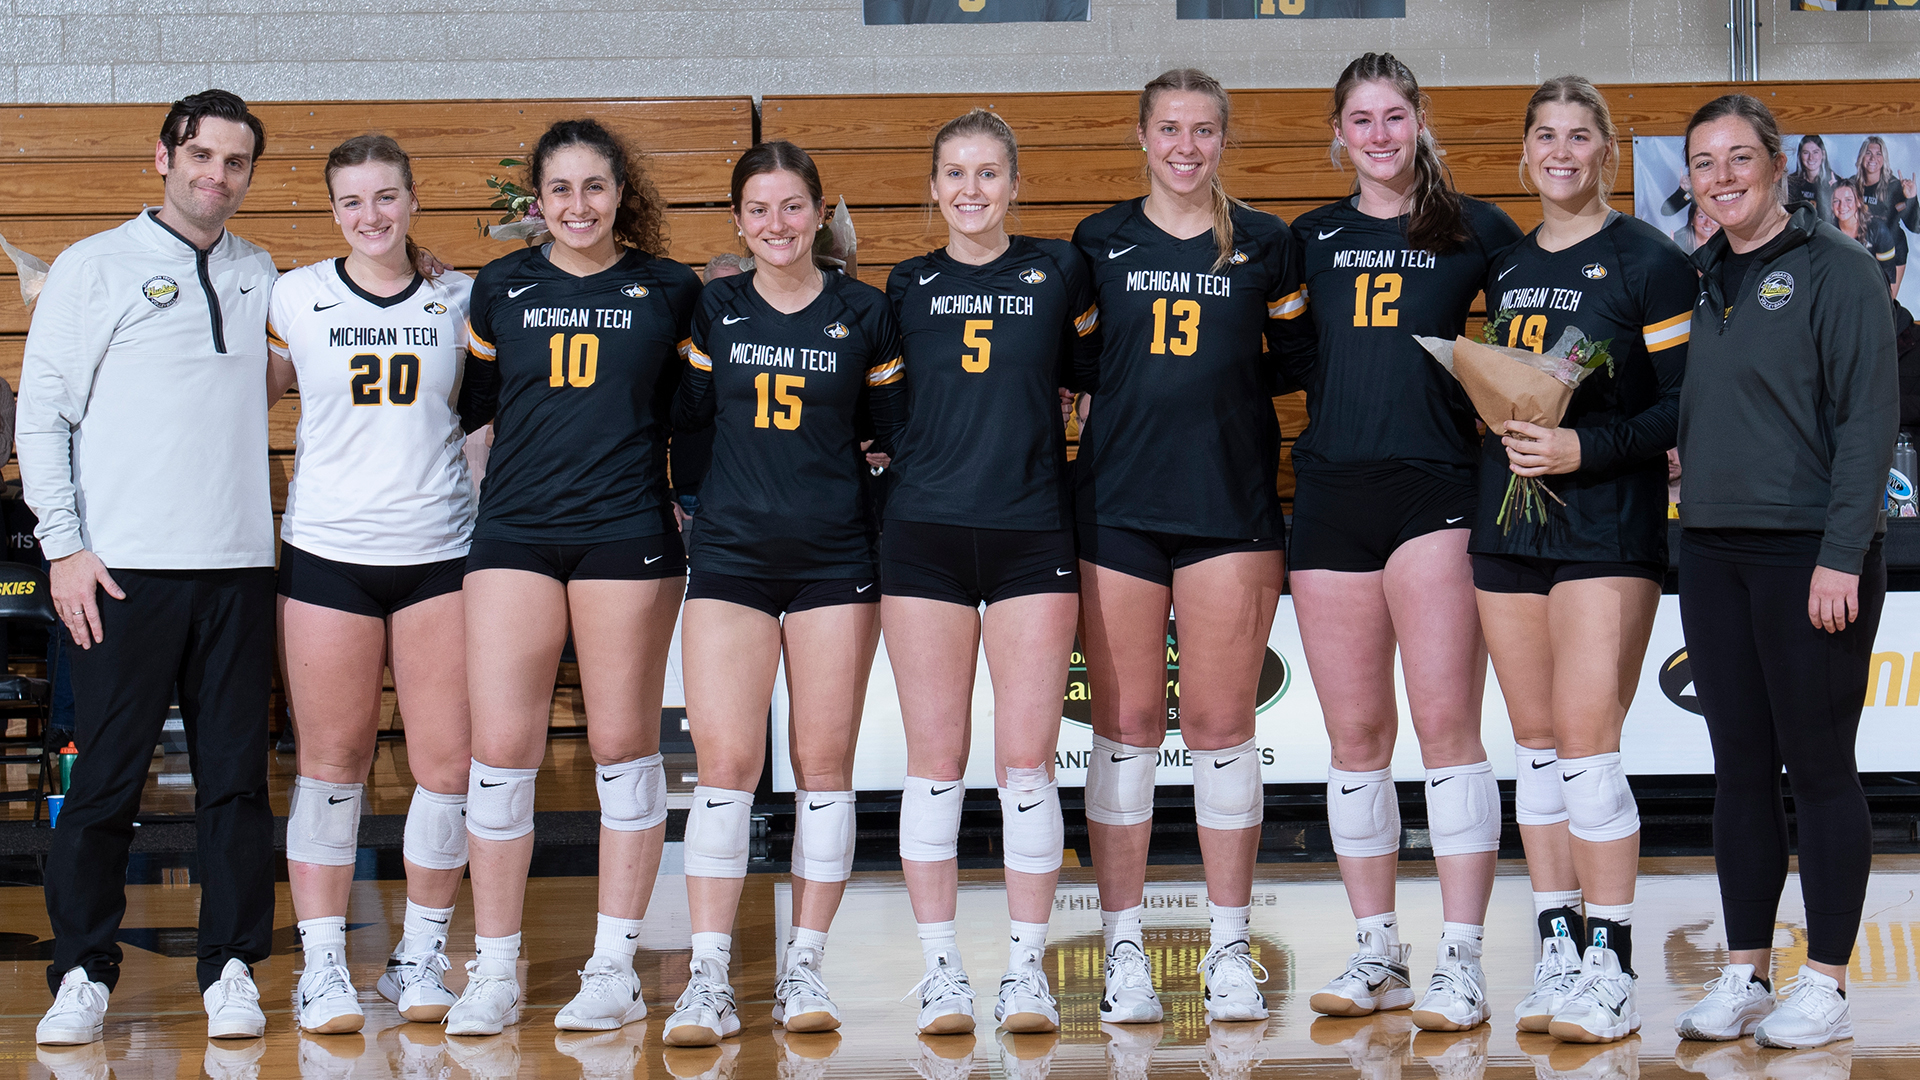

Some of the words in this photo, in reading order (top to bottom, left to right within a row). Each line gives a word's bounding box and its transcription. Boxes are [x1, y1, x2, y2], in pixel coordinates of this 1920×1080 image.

[1333, 250, 1395, 268] MICHIGAN
[1400, 250, 1436, 269] TECH
[1126, 270, 1191, 293] MICHIGAN
[1196, 273, 1231, 297] TECH
[930, 294, 993, 315] MICHIGAN
[998, 296, 1033, 316] TECH
[1353, 273, 1403, 327] 12
[1499, 287, 1550, 312] MICHIGAN
[1549, 288, 1583, 312] TECH
[523, 307, 589, 328] MICHIGAN
[595, 309, 632, 329] TECH
[1150, 298, 1201, 357] 13
[329, 327, 397, 347] MICHIGAN
[403, 327, 438, 346] TECH
[961, 319, 993, 373] 5
[1507, 314, 1548, 354] 19
[549, 333, 599, 388] 10
[729, 342, 795, 368] MICHIGAN
[800, 348, 837, 373] TECH
[349, 352, 421, 406] 20
[754, 372, 806, 431] 15
[0, 581, 36, 595] KIES
